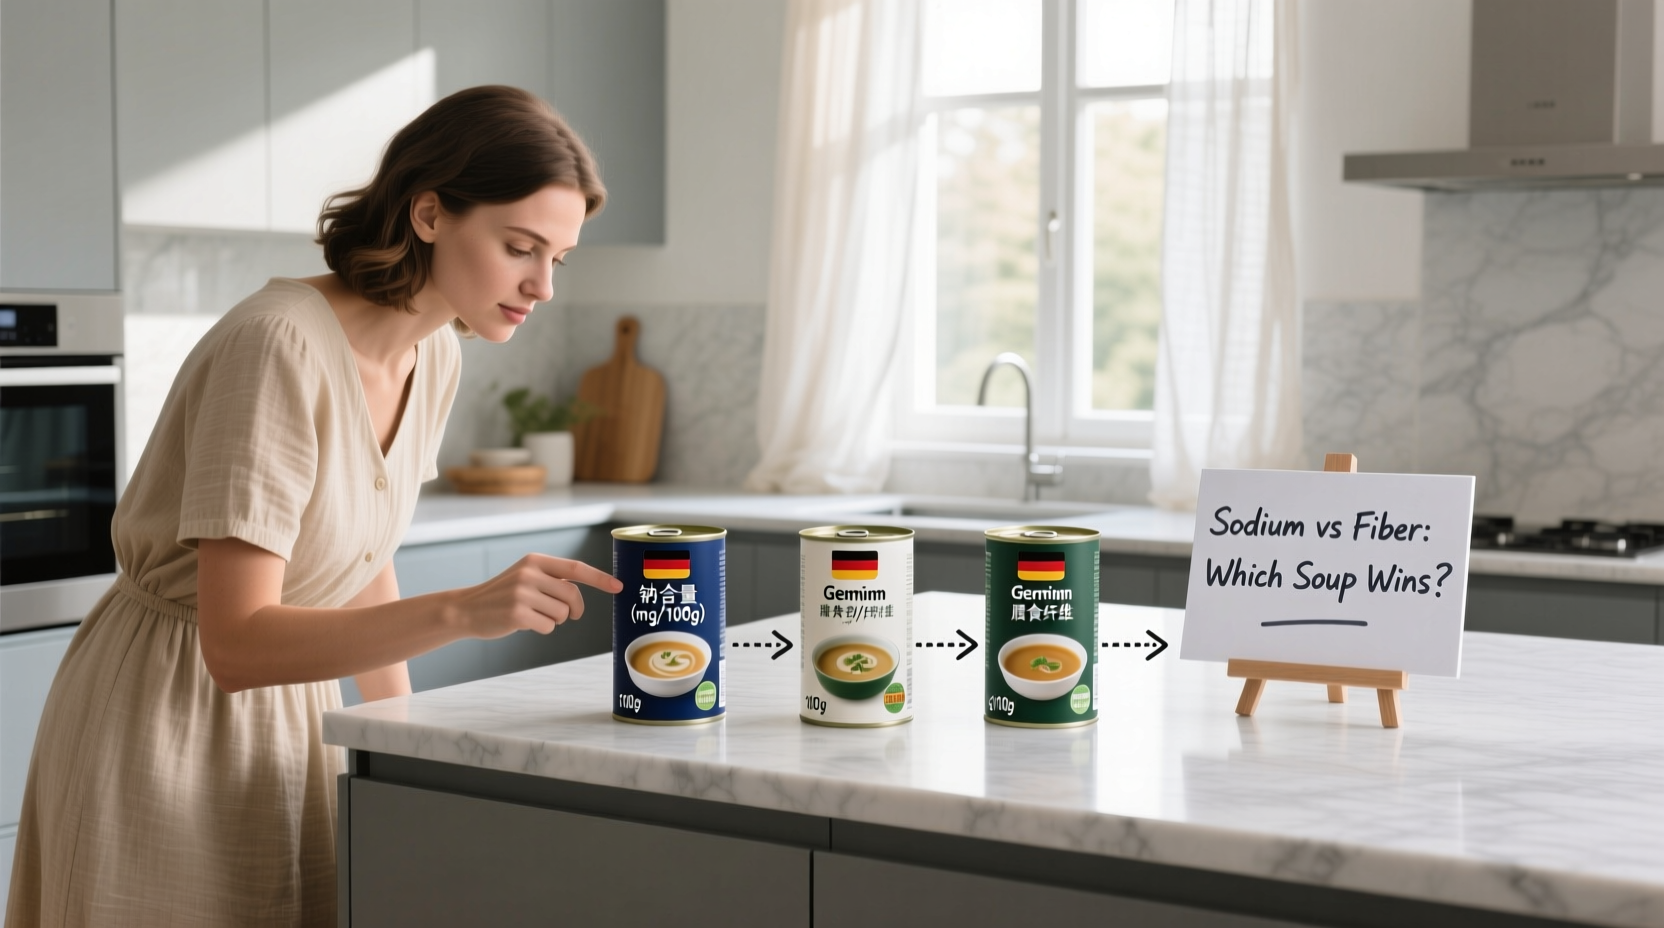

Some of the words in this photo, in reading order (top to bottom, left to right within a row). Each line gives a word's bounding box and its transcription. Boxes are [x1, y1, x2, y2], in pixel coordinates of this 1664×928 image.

[1209, 505, 1304, 537] Sodium
[1316, 520, 1342, 539] vs
[1353, 511, 1431, 542] Fiber:
[1206, 557, 1283, 588] Which
[1292, 560, 1357, 603] Soup
[1367, 562, 1453, 598] Wins?
[631, 603, 705, 627] (mg/100g)
